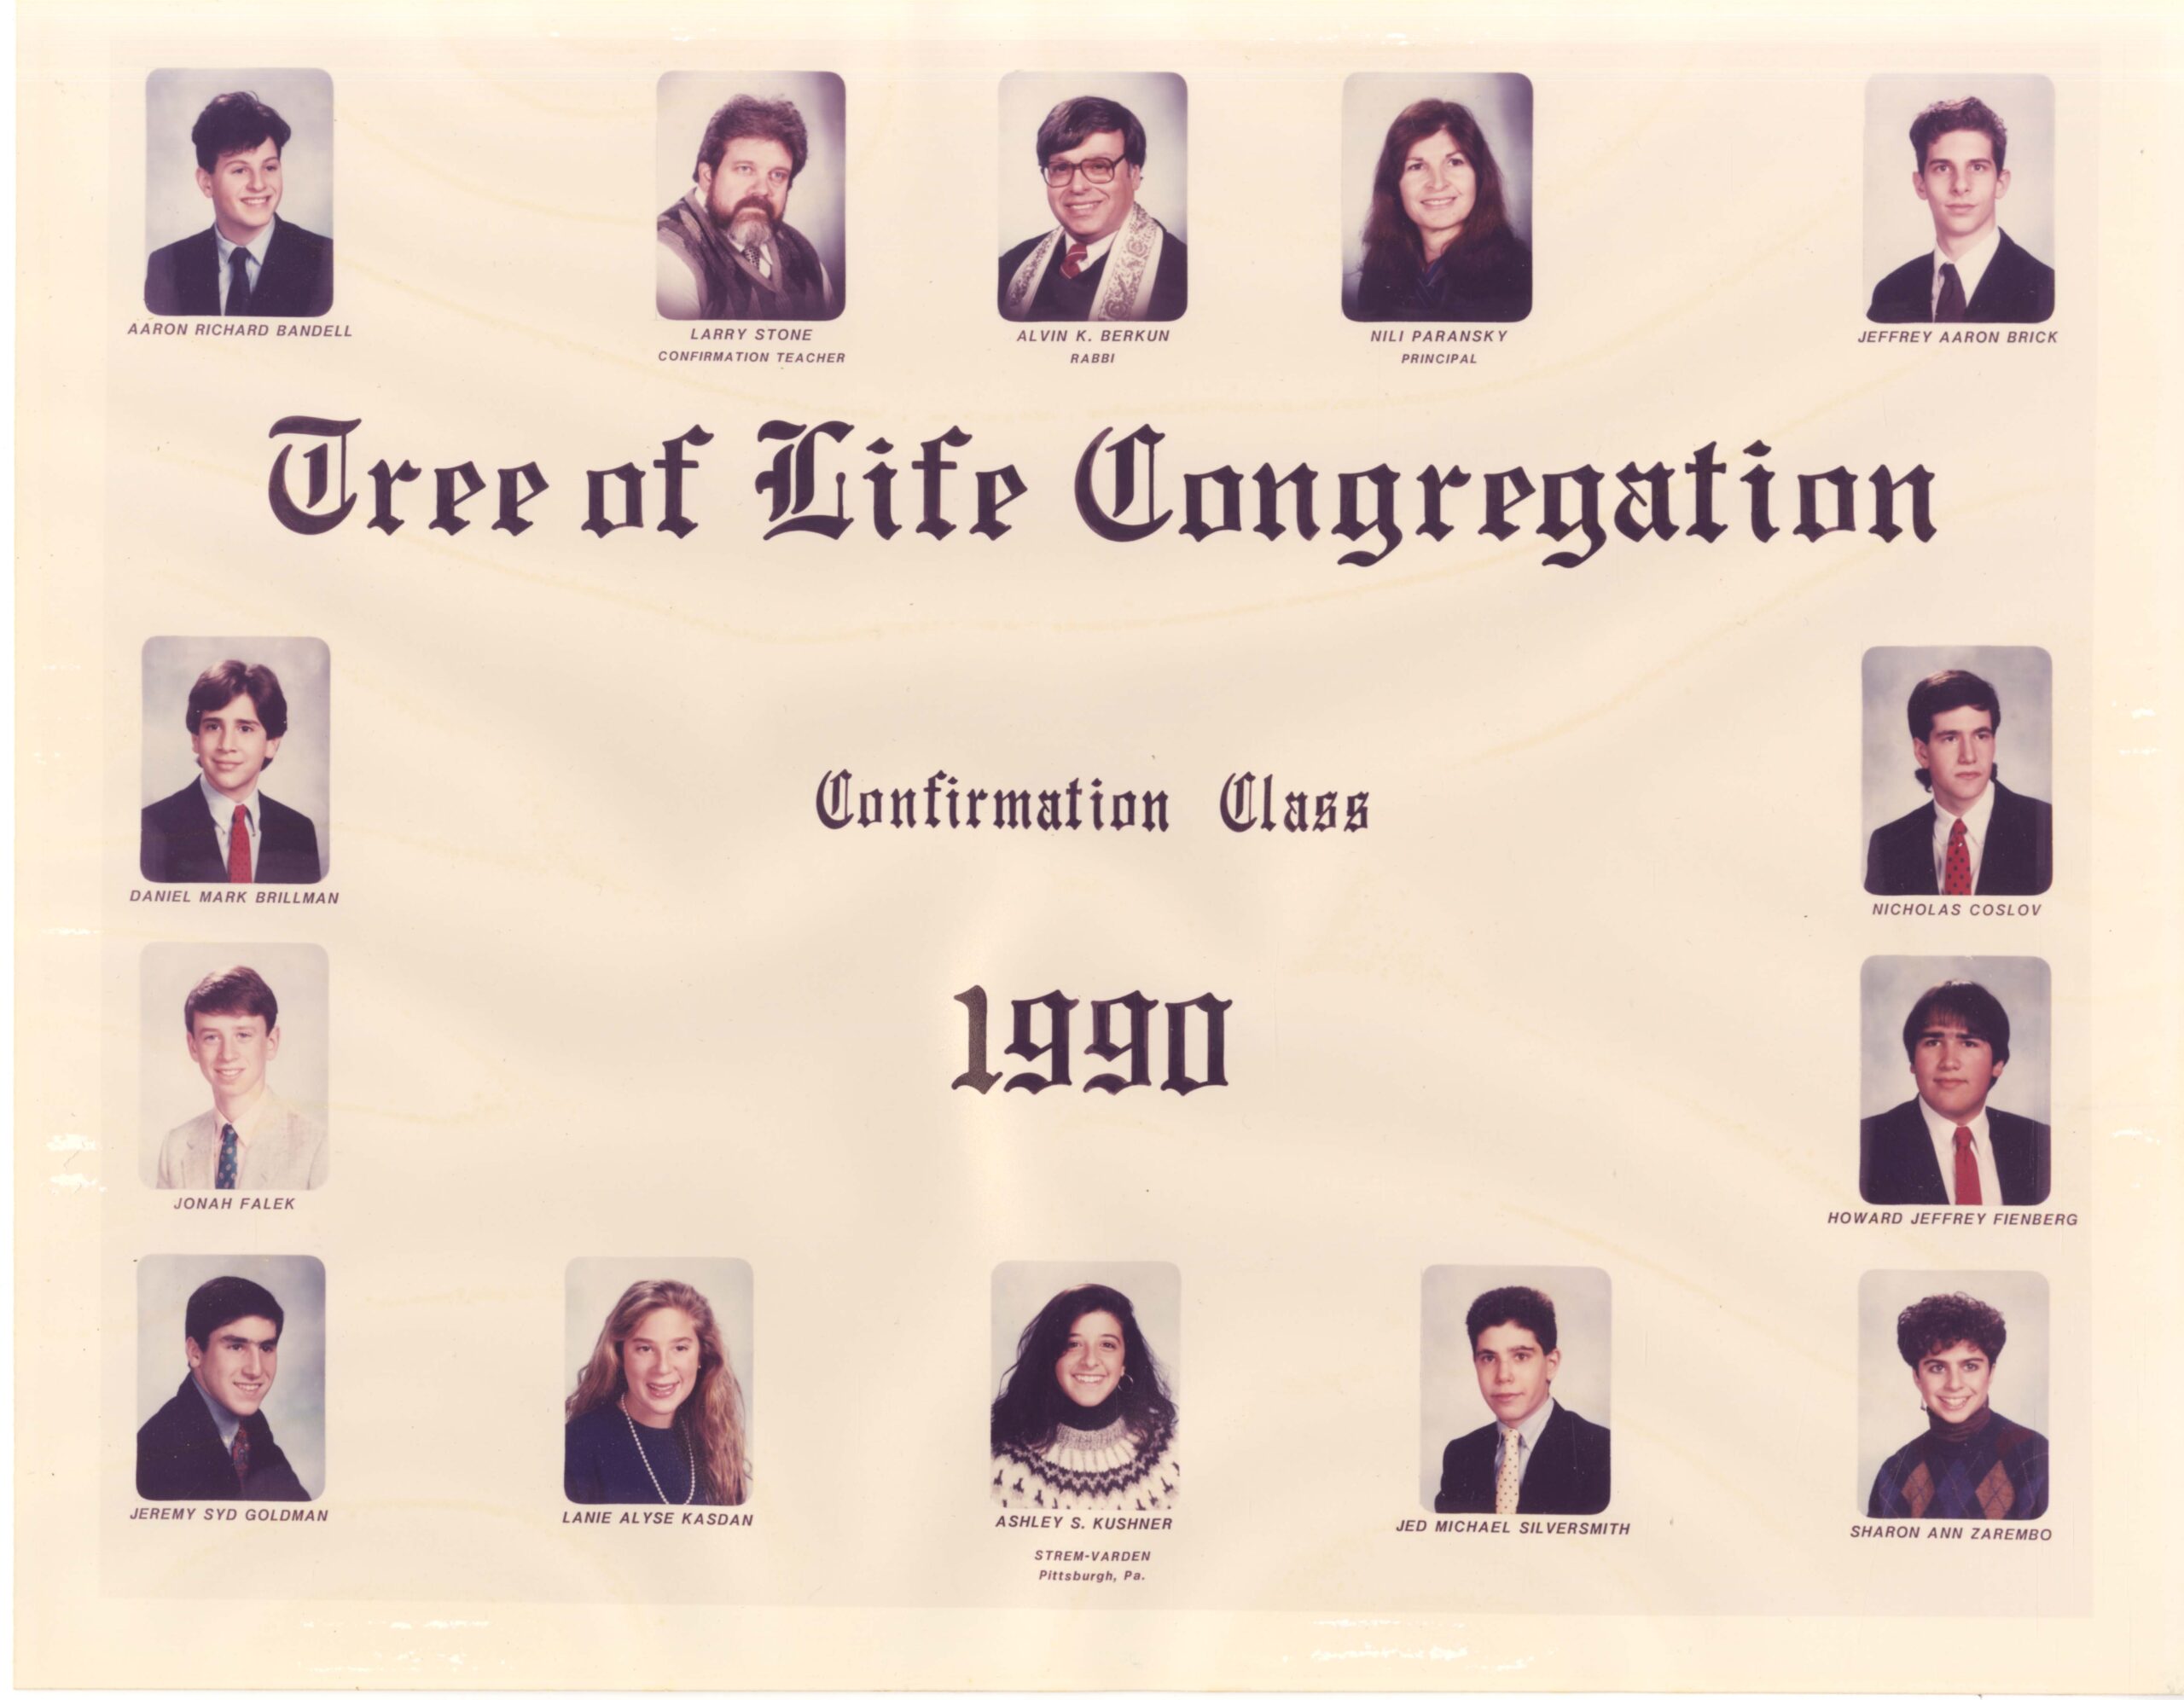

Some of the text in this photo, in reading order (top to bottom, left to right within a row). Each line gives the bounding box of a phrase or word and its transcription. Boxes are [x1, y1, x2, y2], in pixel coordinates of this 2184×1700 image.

[127, 322, 351, 337] AARON RICHARD BANDELL
[690, 328, 813, 341] LARRY STONE
[1016, 329, 1170, 342] ALVIN K. BERKUN
[1370, 329, 1507, 343] NILI PARANSKY
[1857, 330, 2058, 344] JEFFREY AARON BRICK
[658, 351, 845, 363] CONFIRMATION TEACHER
[1070, 353, 1115, 363] RABBI
[1401, 353, 1477, 364] PRINCIPAL
[268, 415, 1937, 569] Tree of Life Congregation
[816, 769, 1369, 833] Confirmation Class
[130, 890, 340, 904] DANIEL MARK BRILLMAN
[1872, 902, 2042, 916] NICHOLAS COSLOV
[950, 984, 1234, 1097] 1990
[173, 1197, 295, 1210] JONAH FALEK
[1827, 1211, 2077, 1226] HOWARD JEFFREY FIENBERG
[130, 1507, 328, 1522] JEREMY SYD GOLDMAN
[562, 1511, 753, 1527] LANIE ALYSE KASDAN
[995, 1515, 1173, 1530] ASHLEY S. KUSHNER
[1396, 1519, 1630, 1535] JED MICHAEL SILVERSMITH
[1850, 1525, 2052, 1541] SHARON ANN ZAREMBO
[1034, 1550, 1151, 1562] STREM-VARDEN
[1039, 1569, 1145, 1583] Pittsburgh, Pa.
